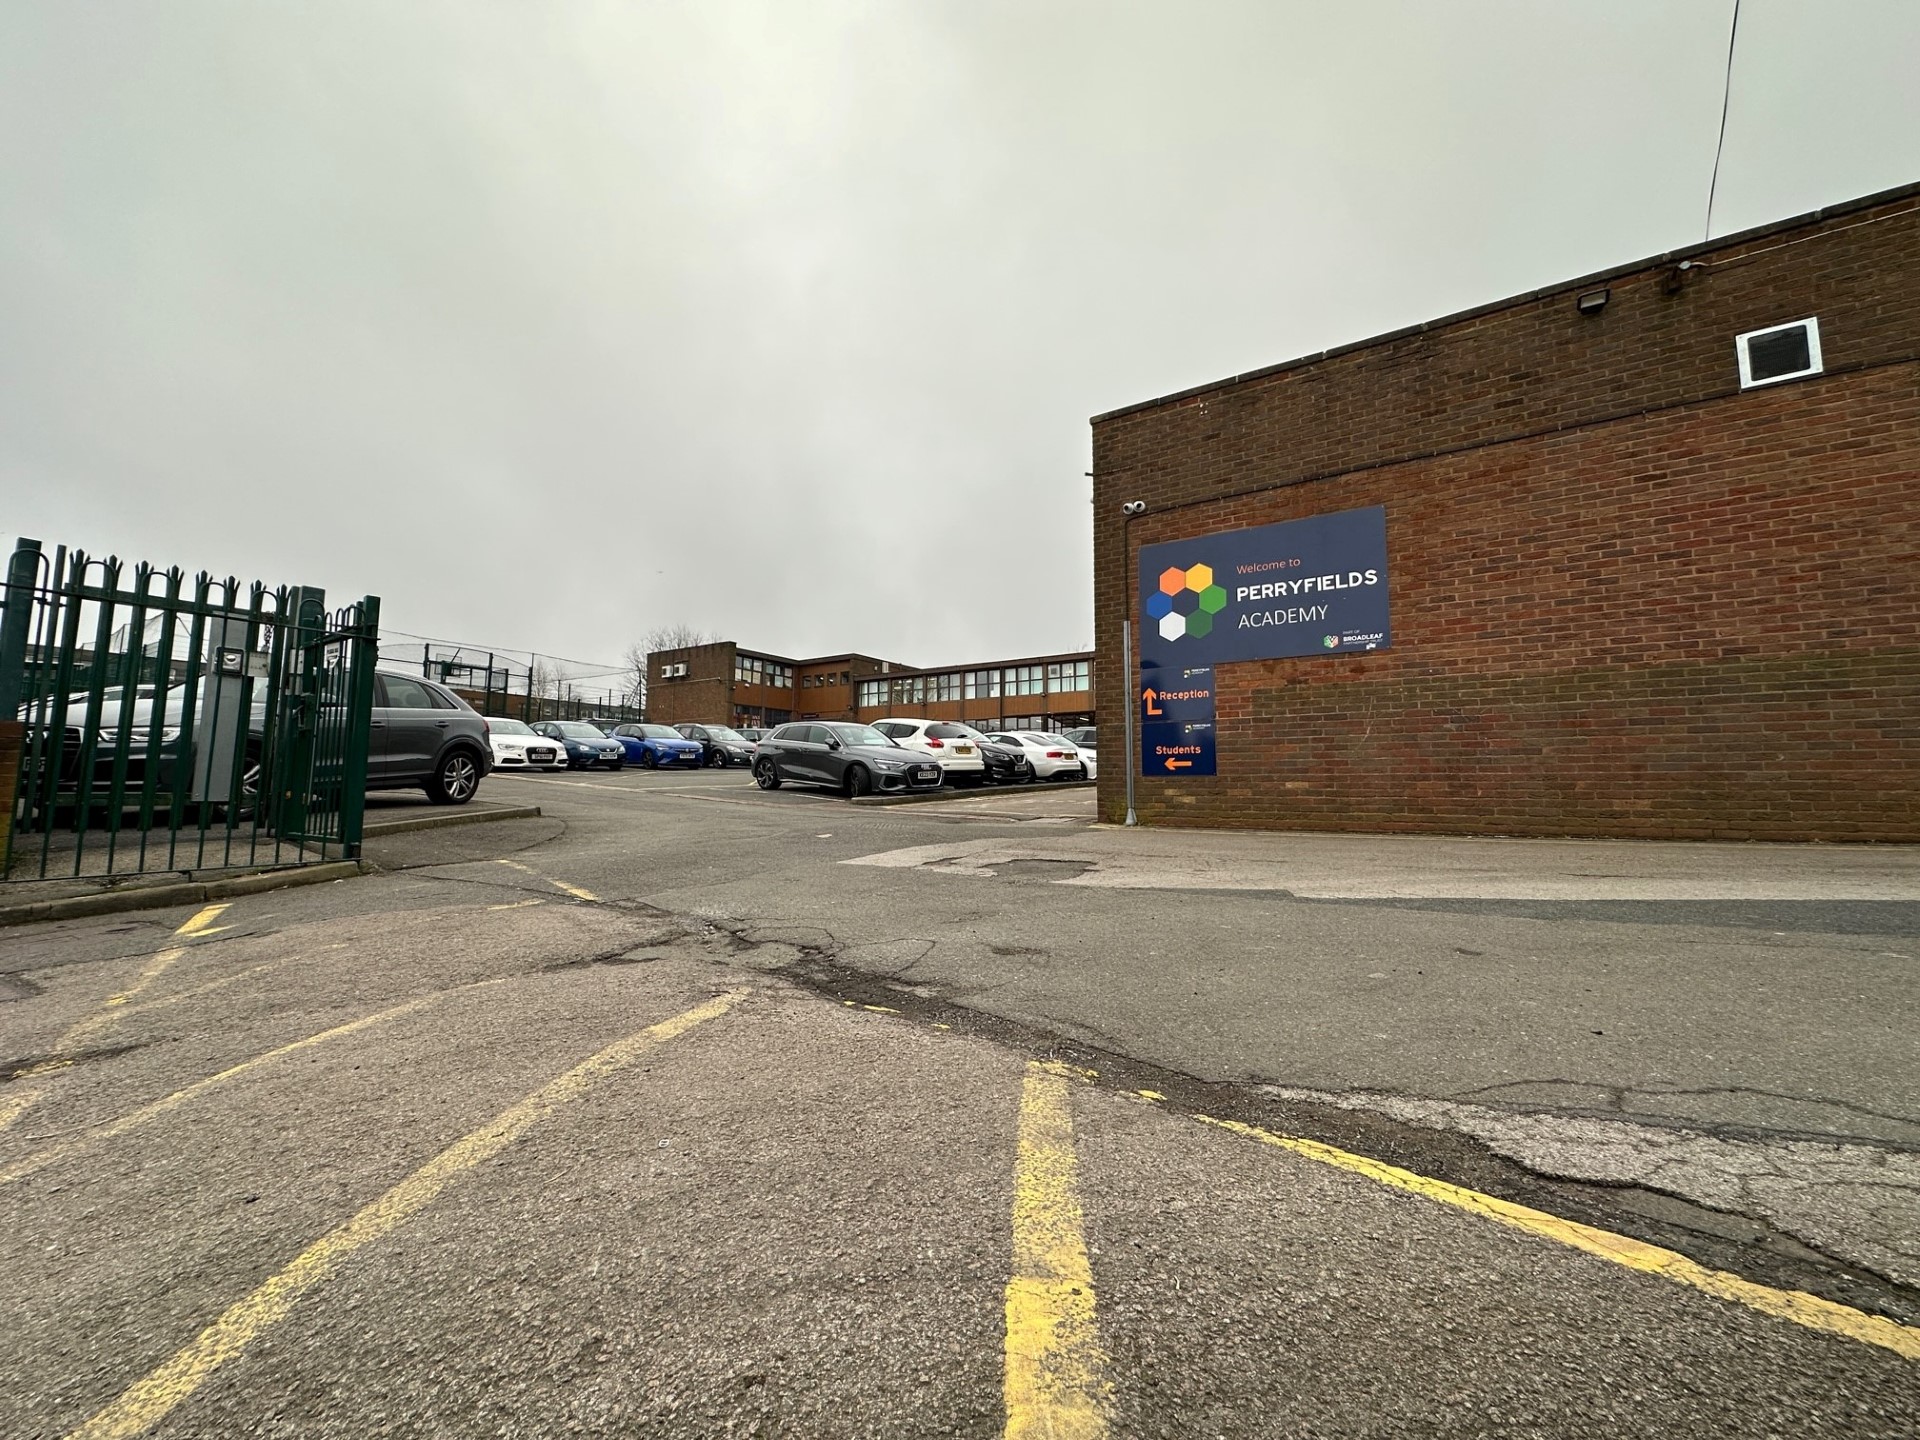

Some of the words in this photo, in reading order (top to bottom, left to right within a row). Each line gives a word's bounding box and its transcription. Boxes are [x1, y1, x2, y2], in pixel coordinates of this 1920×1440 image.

[1237, 560, 1286, 575] Welcome
[1288, 558, 1300, 568] to
[1237, 569, 1377, 602] PERRYFIELDS
[1238, 604, 1328, 629] ACADEMY
[1343, 633, 1383, 642] BROADLEAF
[1159, 689, 1209, 701] Reception
[1155, 745, 1201, 755] Students
